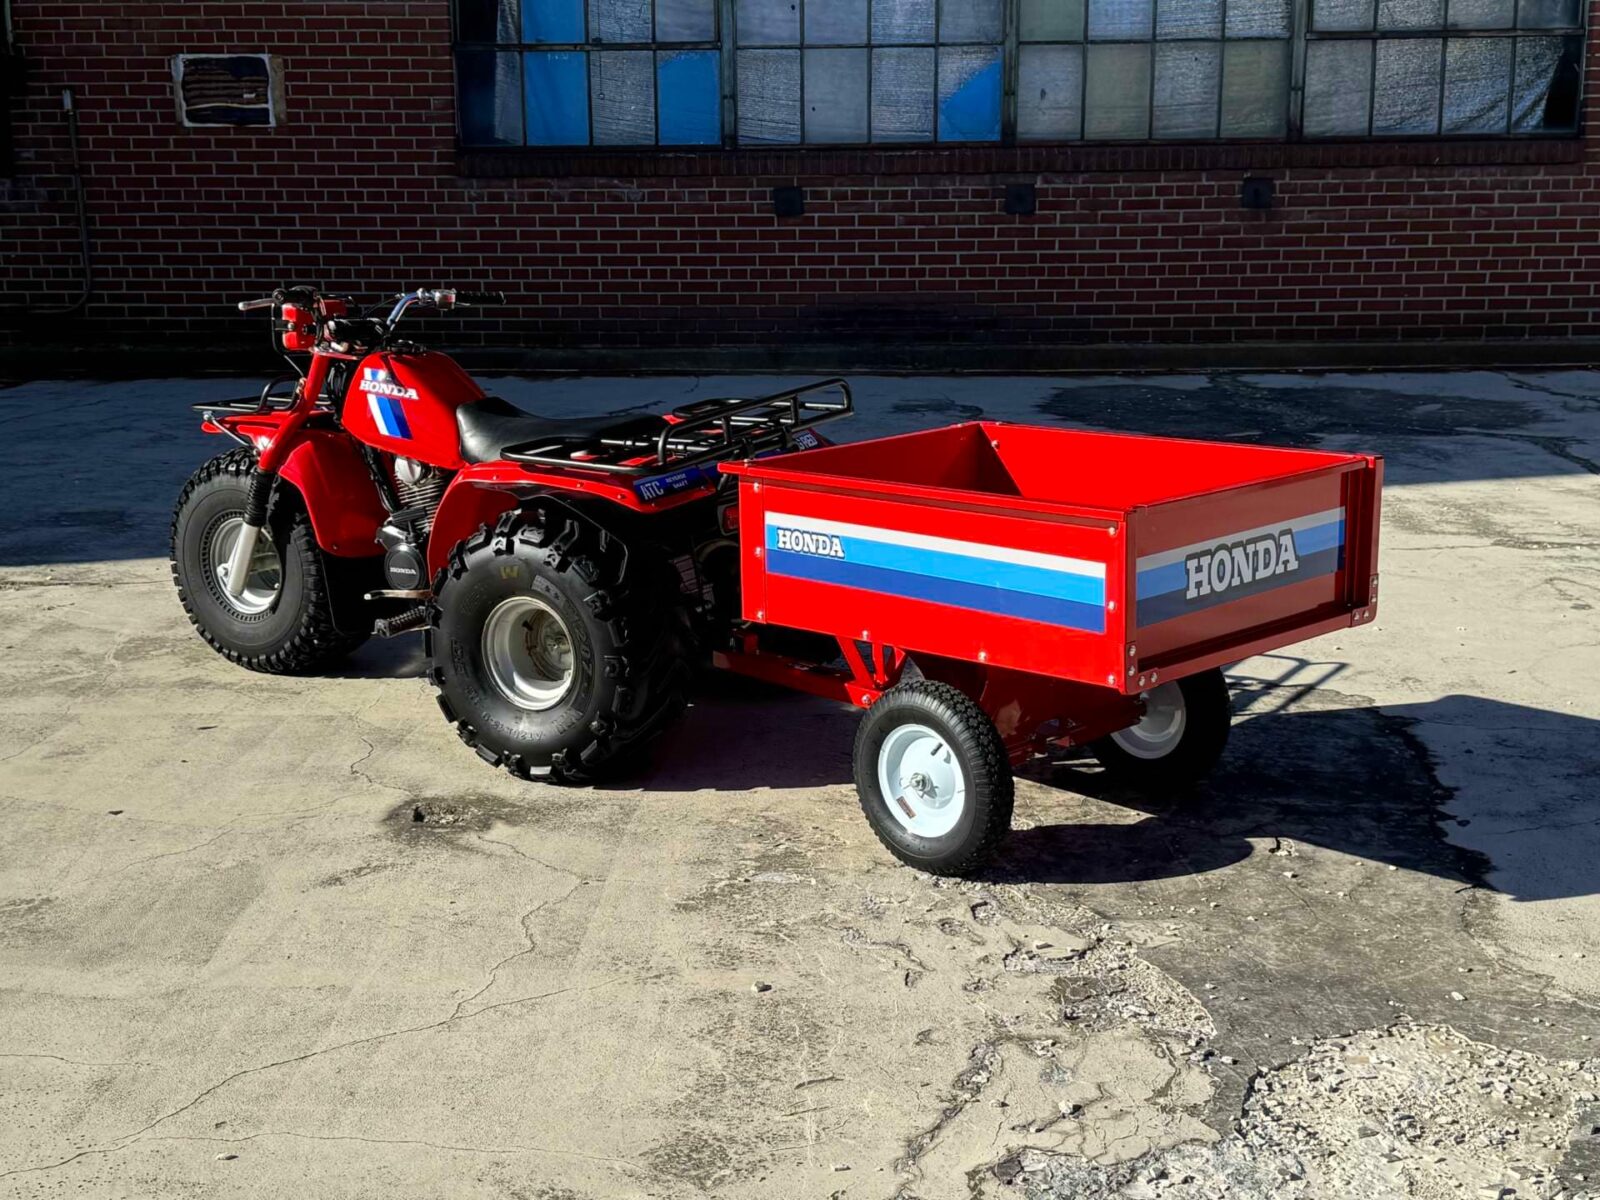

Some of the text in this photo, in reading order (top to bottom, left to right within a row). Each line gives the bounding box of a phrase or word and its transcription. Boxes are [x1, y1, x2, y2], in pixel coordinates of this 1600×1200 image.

[359, 380, 420, 400] HONDA
[640, 480, 664, 500] ATC
[776, 528, 845, 559] HONDA
[389, 566, 417, 575] HONDA
[1185, 530, 1299, 600] HONDA
